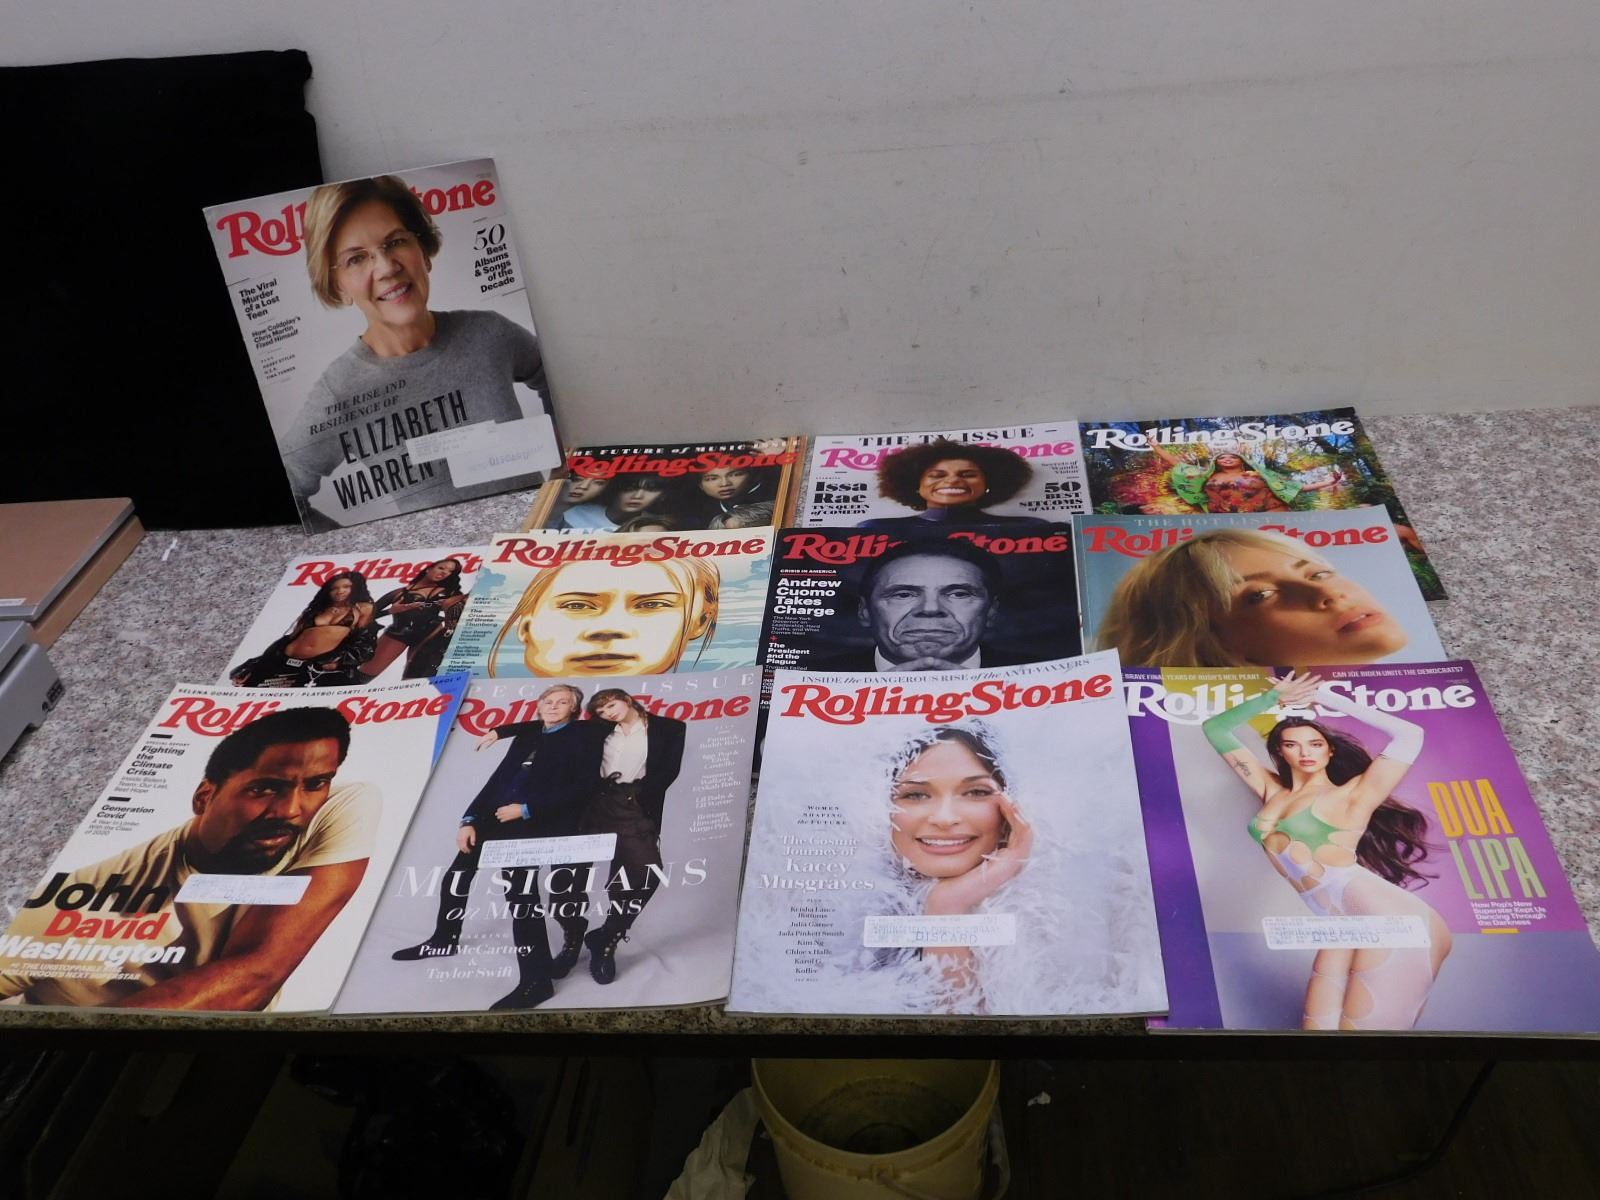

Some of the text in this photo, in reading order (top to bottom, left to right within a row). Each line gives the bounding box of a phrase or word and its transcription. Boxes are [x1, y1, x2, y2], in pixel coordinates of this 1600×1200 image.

[473, 223, 505, 251] 50
[486, 243, 507, 255] Best
[475, 252, 509, 268] Albums
[482, 260, 511, 275] Songs
[488, 269, 513, 281] of the
[239, 278, 277, 298] The Viral
[480, 276, 515, 293] Decade
[242, 290, 274, 305] Murder
[245, 305, 253, 313] of
[261, 295, 280, 307] Lost
[246, 309, 268, 320] Teen
[252, 316, 301, 337] How Coldplay's
[254, 325, 294, 343] Chris Martin
[256, 329, 299, 350] Fixed Himself
[325, 401, 350, 415] THE
[352, 388, 381, 406] RISE
[309, 403, 381, 435] RESILIENCE
[339, 389, 467, 465] ELIZABETH
[859, 427, 1034, 446] THE TV ISSUE
[1087, 419, 1355, 451] RollingStone
[600, 448, 664, 456] FUTURE
[567, 452, 800, 479] RollingStone
[815, 482, 867, 491] Issa
[1045, 481, 1081, 493] 50
[814, 493, 866, 503] Rae
[1020, 499, 1083, 507] SITCOMS
[1134, 518, 1175, 527] THE
[492, 536, 766, 569] RollingStone
[777, 578, 842, 587] Andrew
[776, 587, 836, 597] Cuomo
[775, 596, 822, 606] Takes
[773, 605, 835, 617] Charge
[802, 676, 841, 684] INSIDE
[844, 676, 862, 684] the
[864, 675, 938, 684] DANGEROUS
[941, 674, 969, 682] RISE
[1003, 658, 1090, 678] ANTI-VAXXERS
[387, 683, 421, 691] CHURCH
[642, 673, 755, 694] ISSUE
[780, 674, 1112, 725] RollingStone
[141, 745, 185, 756] Fighting
[126, 768, 157, 776] Crisis
[131, 761, 173, 769] Climate
[102, 805, 155, 814] Generation
[1426, 779, 1514, 837] DUA
[783, 835, 858, 846] The Cosmic
[784, 846, 857, 857] Journey of
[786, 858, 850, 877] Kacey
[1448, 837, 1547, 899] LIPA
[394, 857, 707, 898] MUSICIANS
[759, 874, 875, 893] Musgraves
[23, 872, 171, 913] John
[445, 898, 643, 921] on MUSICIANS
[43, 910, 171, 940] David
[0, 934, 186, 966] Washington
[419, 943, 535, 957] Paul McCartney
[427, 966, 513, 981] Taylor Swift
